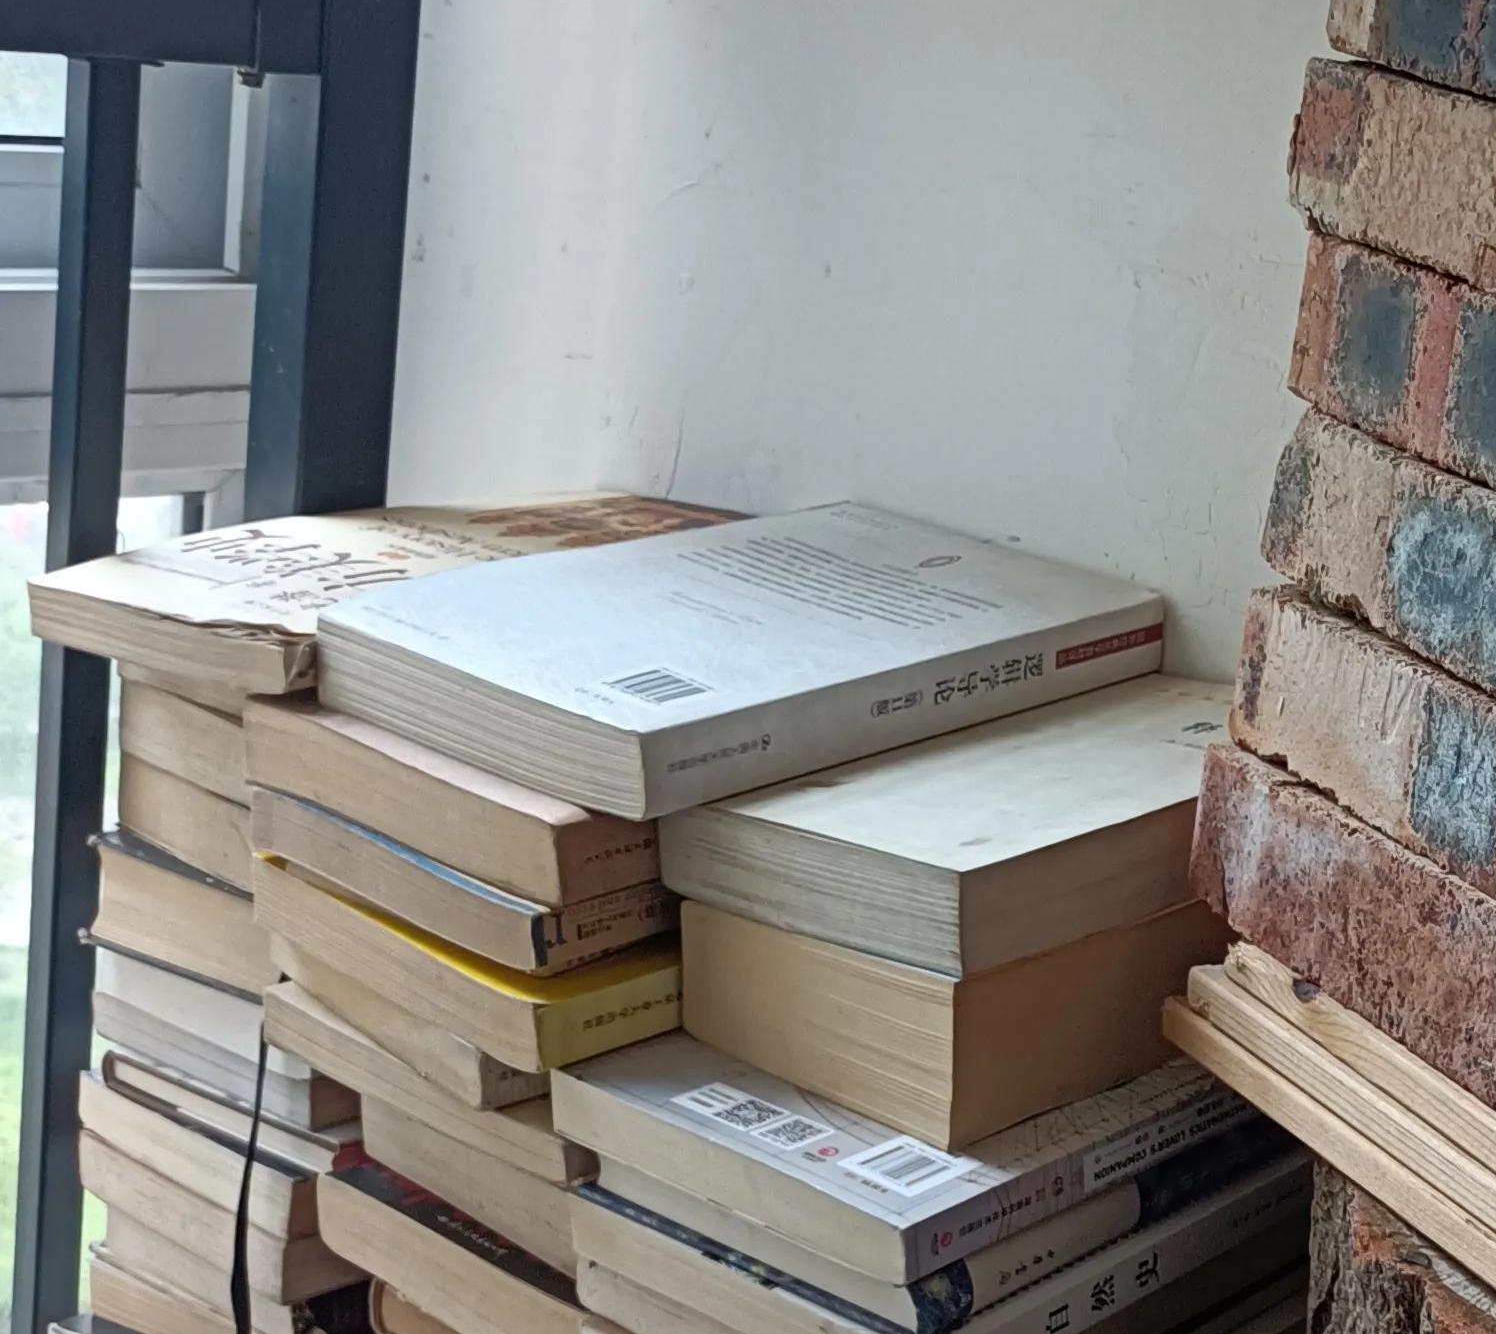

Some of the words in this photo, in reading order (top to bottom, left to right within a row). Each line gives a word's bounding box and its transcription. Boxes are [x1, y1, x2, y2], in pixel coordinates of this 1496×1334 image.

[933, 654, 1045, 704] 逻辑学导论
[1046, 1250, 1161, 1334] 自然史
